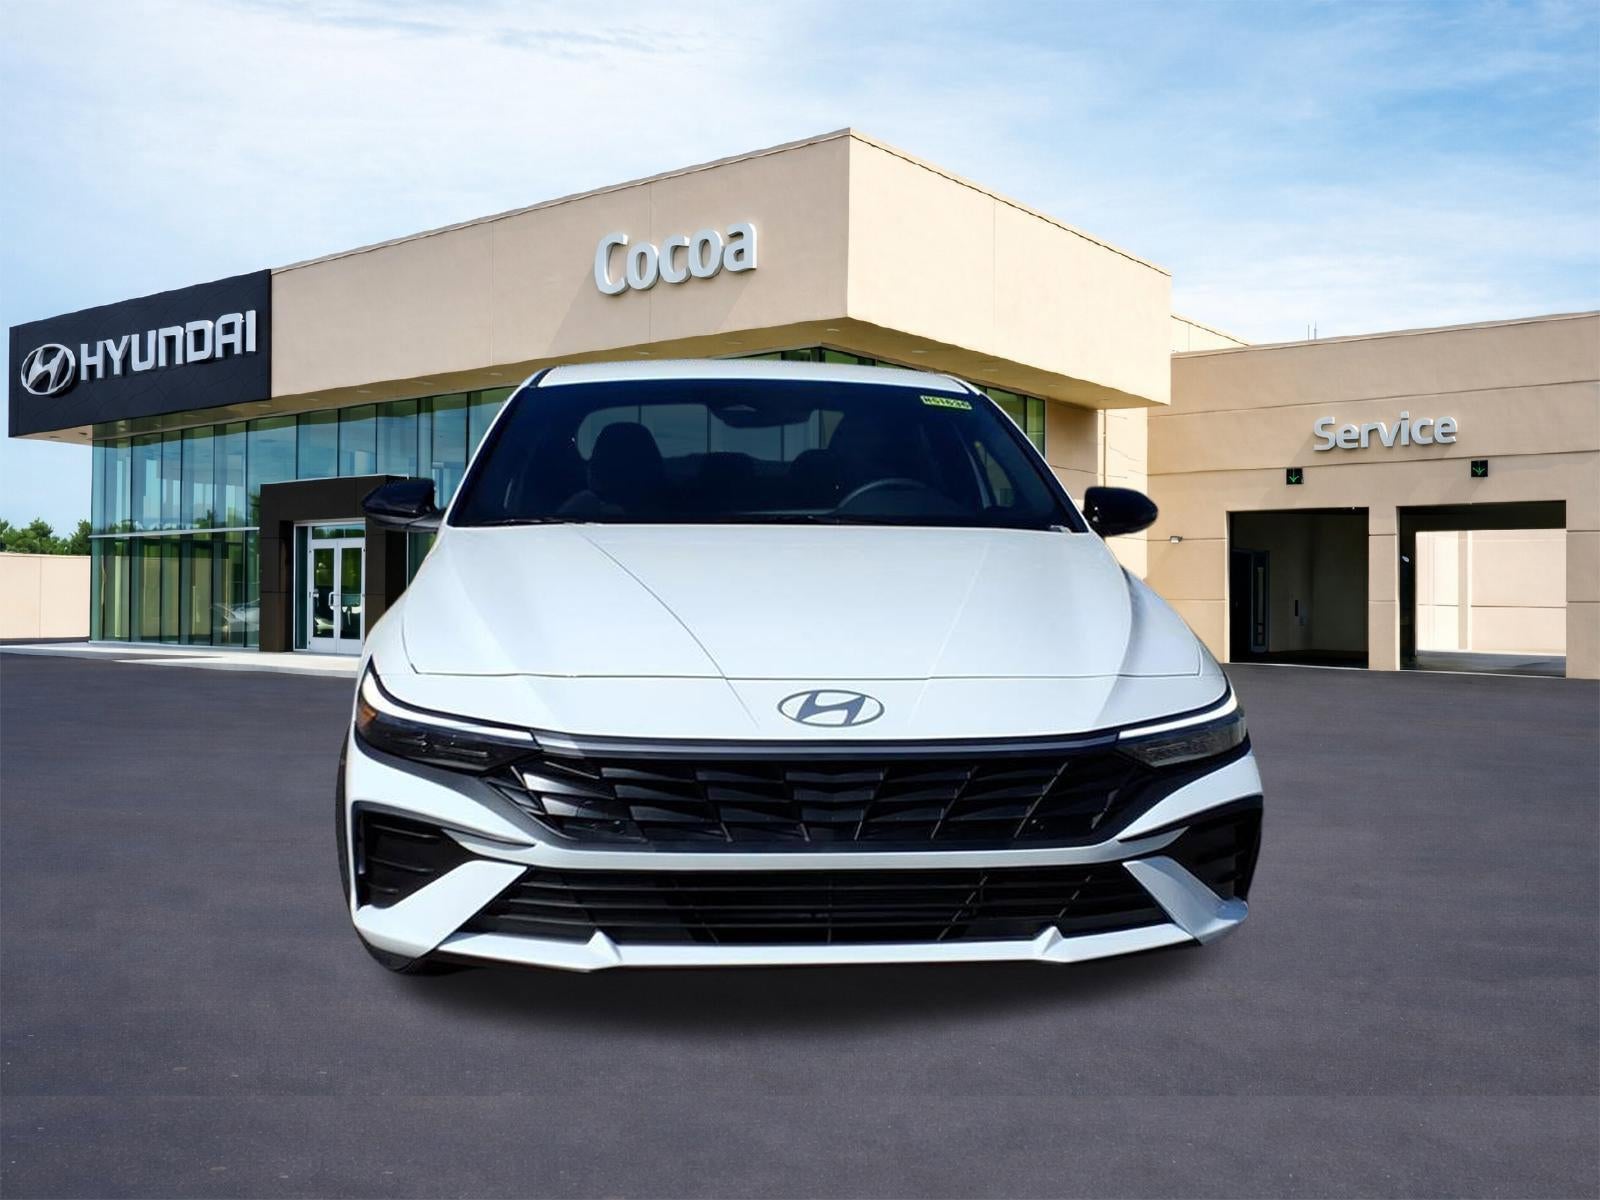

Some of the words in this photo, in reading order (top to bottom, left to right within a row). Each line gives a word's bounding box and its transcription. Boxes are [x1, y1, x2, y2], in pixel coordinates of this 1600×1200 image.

[594, 223, 757, 295] Cocoa
[80, 310, 256, 381] HYUNDAI
[1313, 410, 1458, 451] Service
